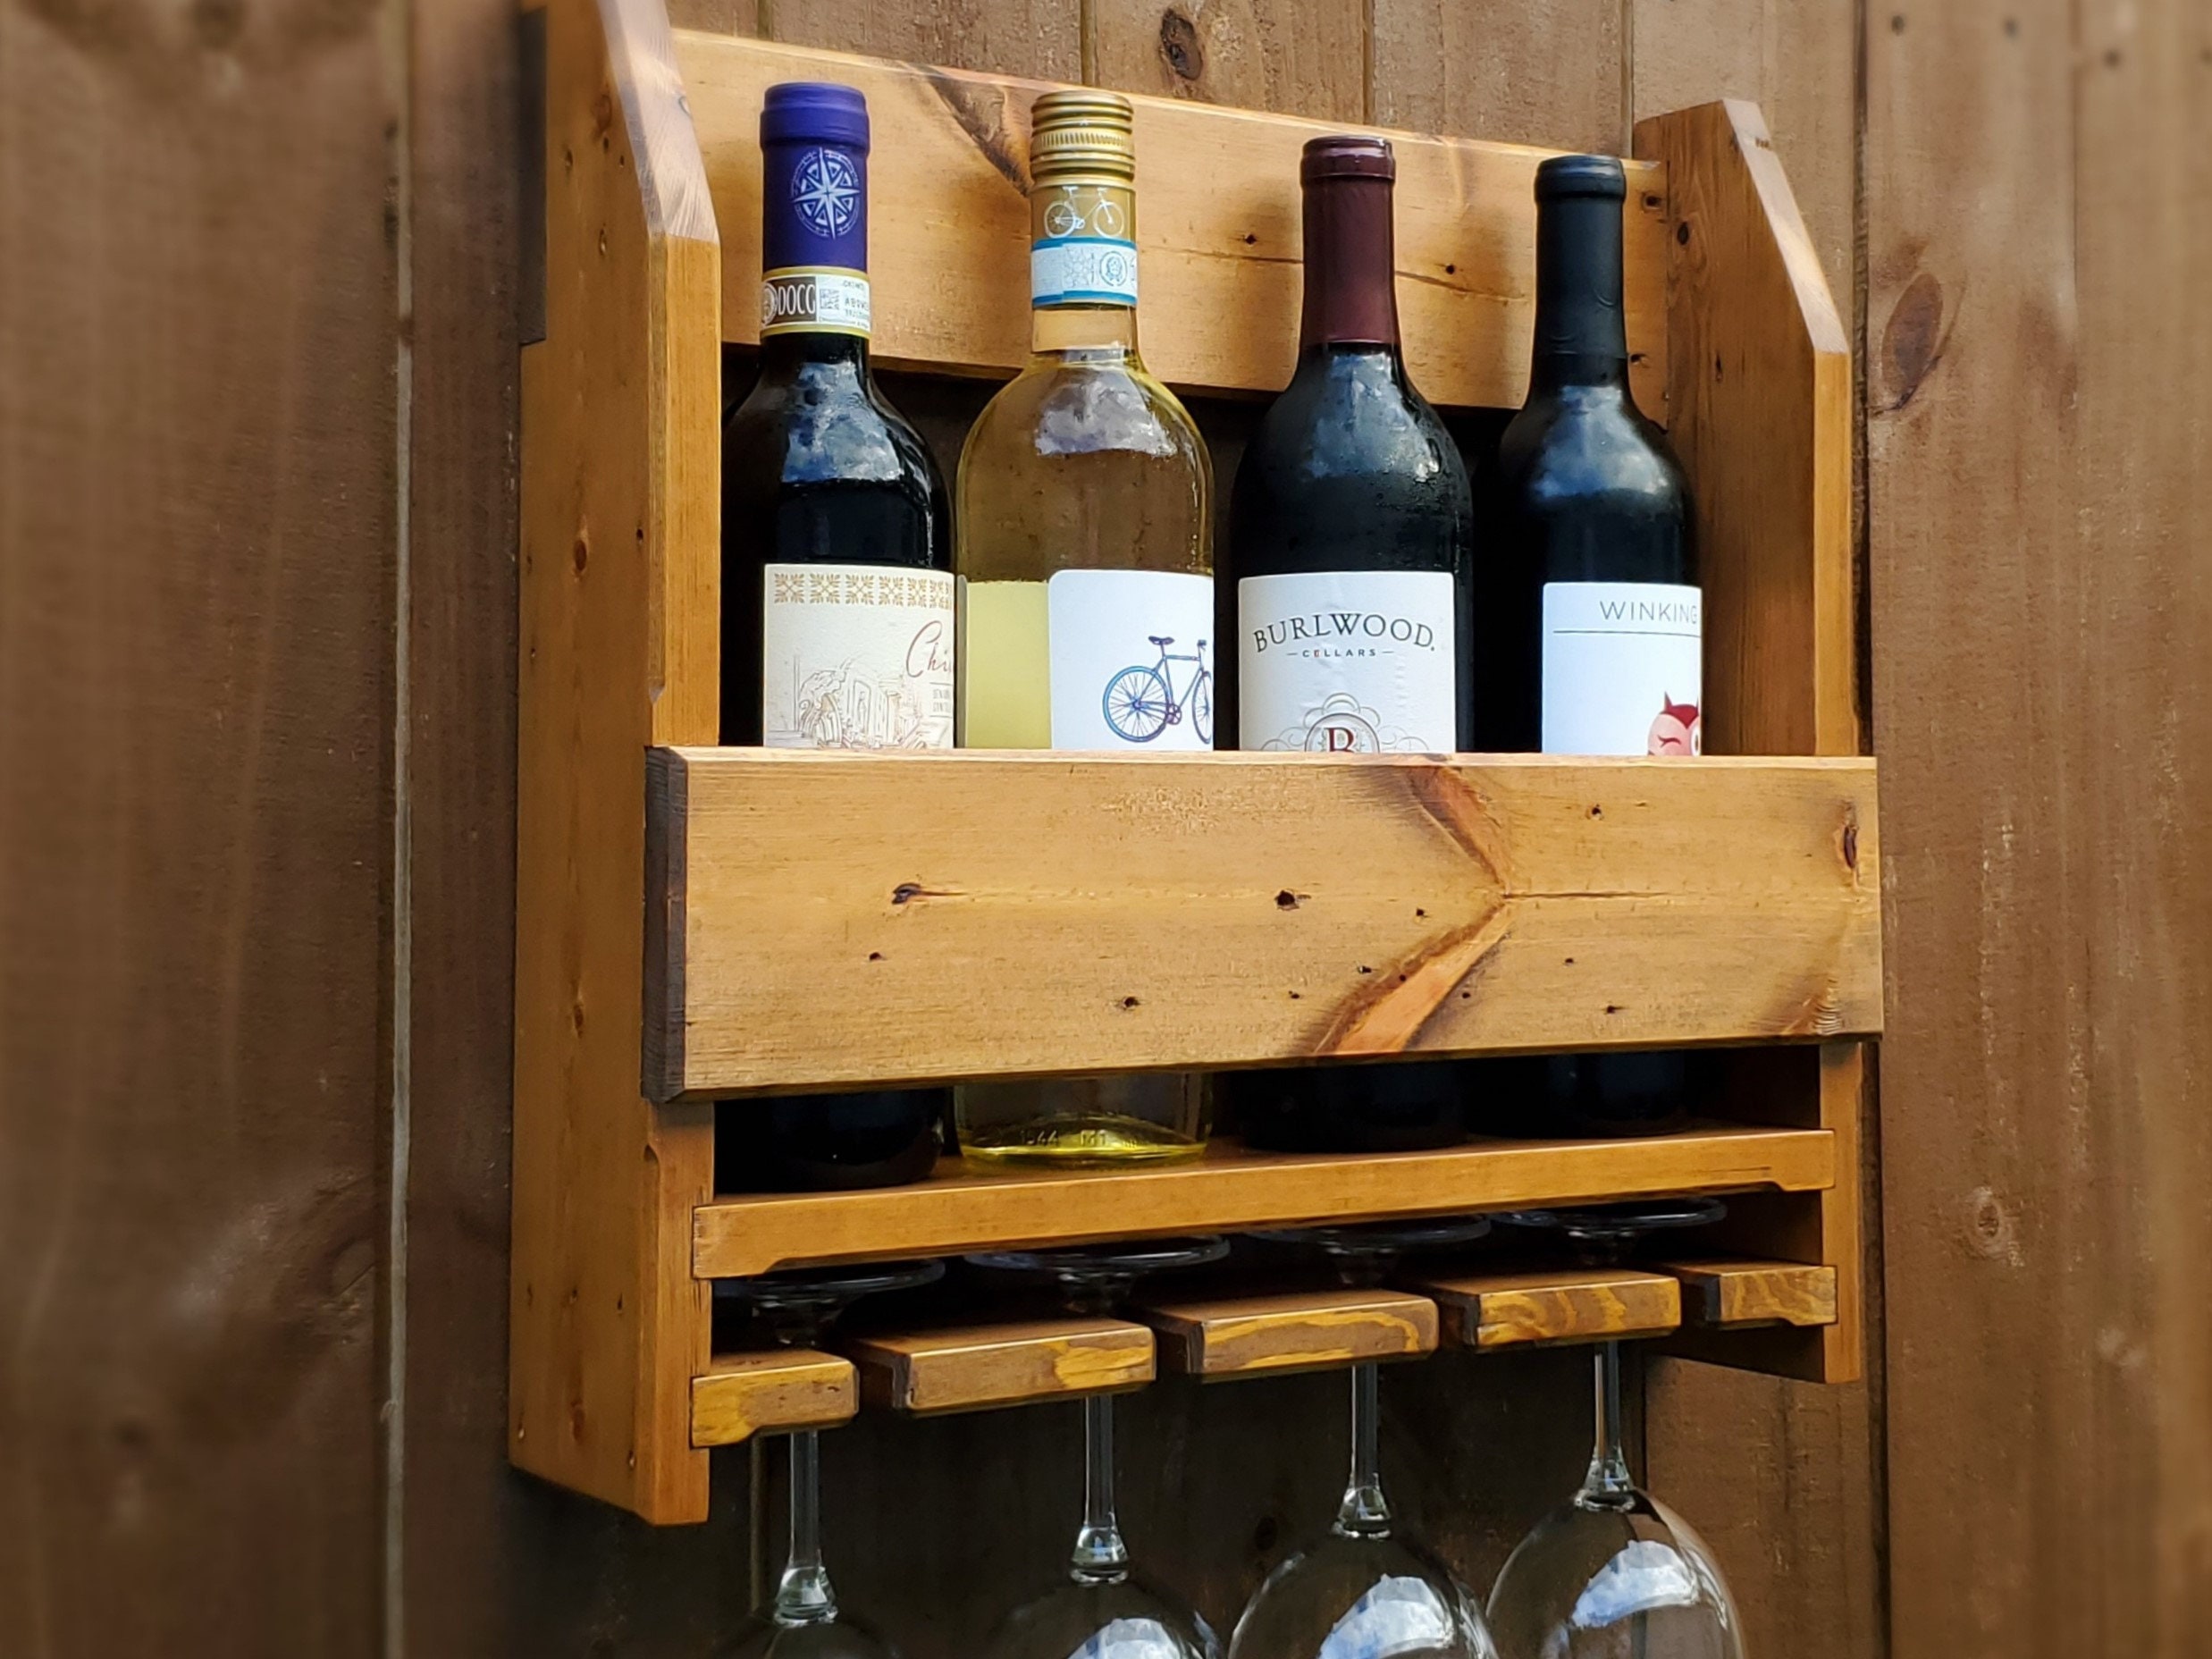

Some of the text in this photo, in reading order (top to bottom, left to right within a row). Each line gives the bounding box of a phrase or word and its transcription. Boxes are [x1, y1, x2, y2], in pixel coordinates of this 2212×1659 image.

[1599, 601, 1697, 624] WINKING
[906, 619, 952, 678] Chi
[1302, 648, 1376, 658] CELLARS
